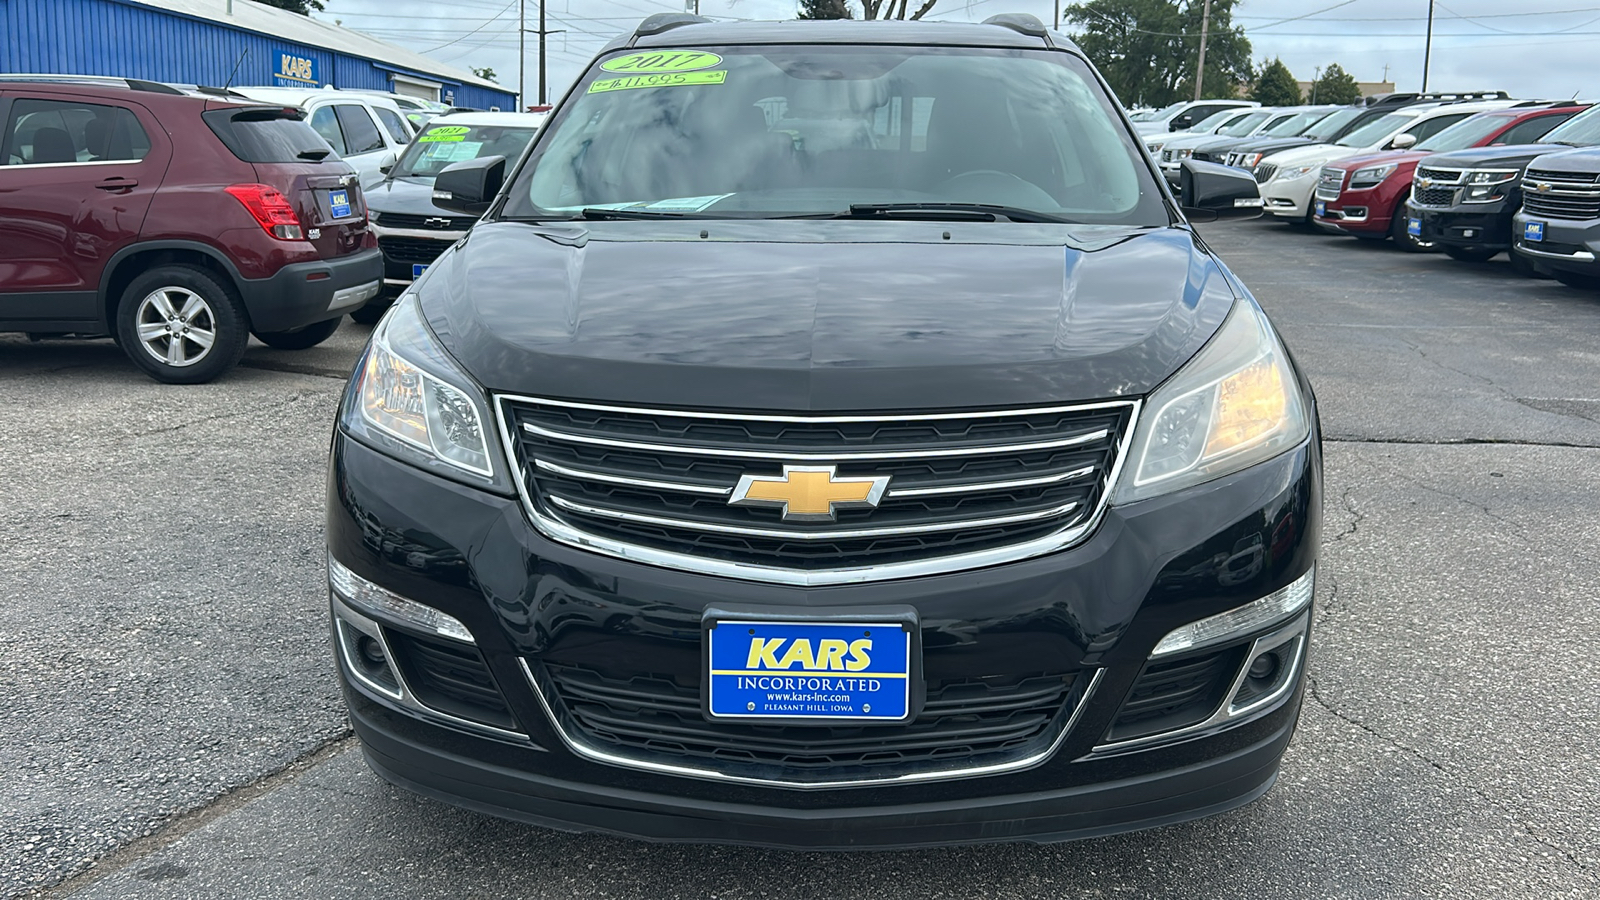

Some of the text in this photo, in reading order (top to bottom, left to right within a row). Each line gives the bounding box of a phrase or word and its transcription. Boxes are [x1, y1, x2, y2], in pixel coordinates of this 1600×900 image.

[281, 53, 312, 79] KARS
[614, 53, 706, 70] 2017
[433, 127, 463, 135] 2021
[332, 193, 346, 205] KARS
[745, 637, 873, 671] KARS
[737, 677, 881, 692] INCORPORATED
[766, 692, 850, 703] www.kars-inc.com
[830, 704, 854, 712] IOWA
